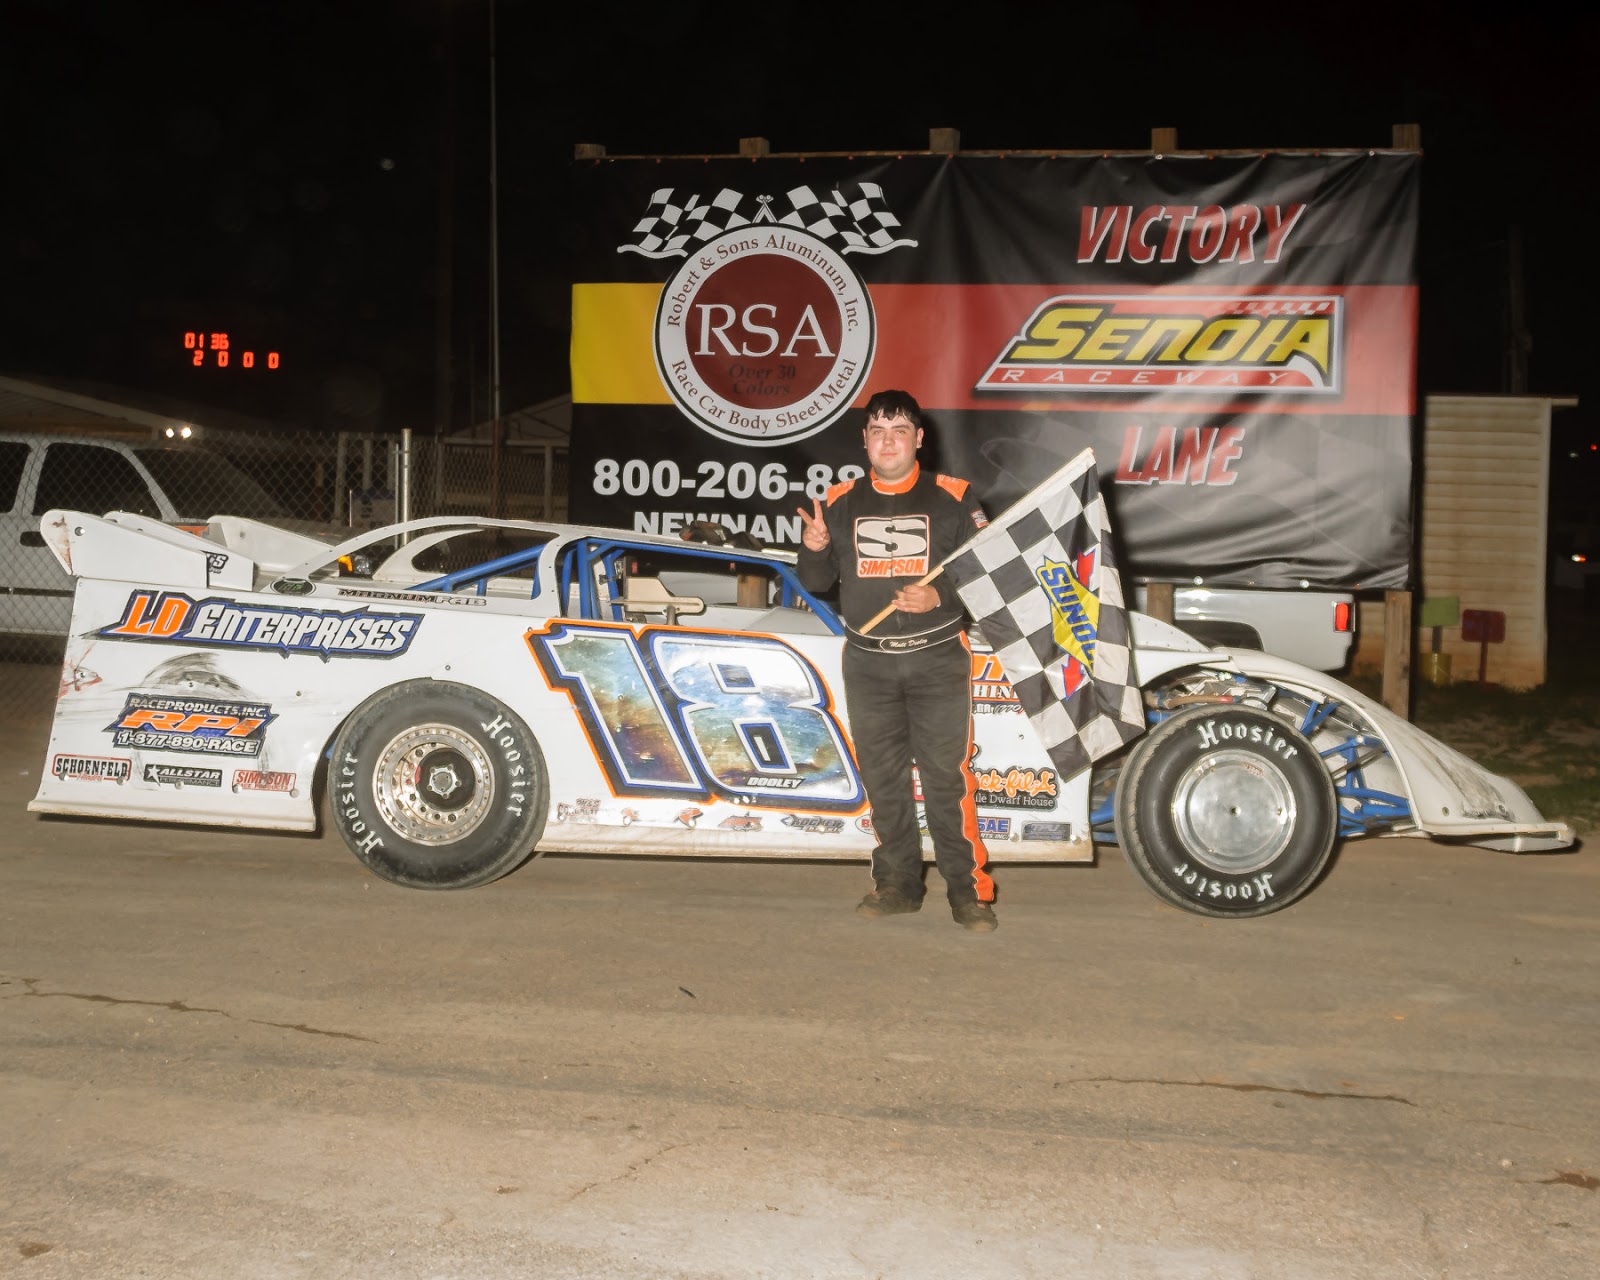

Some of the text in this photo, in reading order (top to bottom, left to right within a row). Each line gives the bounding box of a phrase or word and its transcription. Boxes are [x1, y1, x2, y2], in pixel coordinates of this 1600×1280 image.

[1077, 204, 1306, 264] VICTORY
[667, 233, 859, 332] Robert & Sons Aluminum, Inc.
[694, 303, 835, 358] RSA
[1010, 308, 1329, 374] SENOIA
[672, 358, 857, 434] Race Car Body Sheet Metal
[1002, 369, 1289, 385] RACEWAY
[1115, 426, 1245, 486] LANE
[860, 558, 925, 575] SIMPSON
[112, 594, 415, 652] LD ENTERPRISES
[1041, 567, 1096, 668] SUNOC
[541, 626, 862, 802] 18
[973, 685, 1018, 699] HIN
[118, 709, 265, 737] RPI
[119, 731, 257, 753] 1-877-890-RACE
[1199, 720, 1298, 760] Hoosier
[55, 758, 128, 777] SCHOENFELD
[159, 768, 221, 779] ALLSTAR
[481, 714, 532, 817] Hoosier
[747, 777, 800, 788] DOOLEY
[337, 752, 385, 854] Hoosier
[989, 794, 1021, 806] Dwarf
[1023, 795, 1054, 807] House
[1173, 863, 1274, 902] Hoosier
